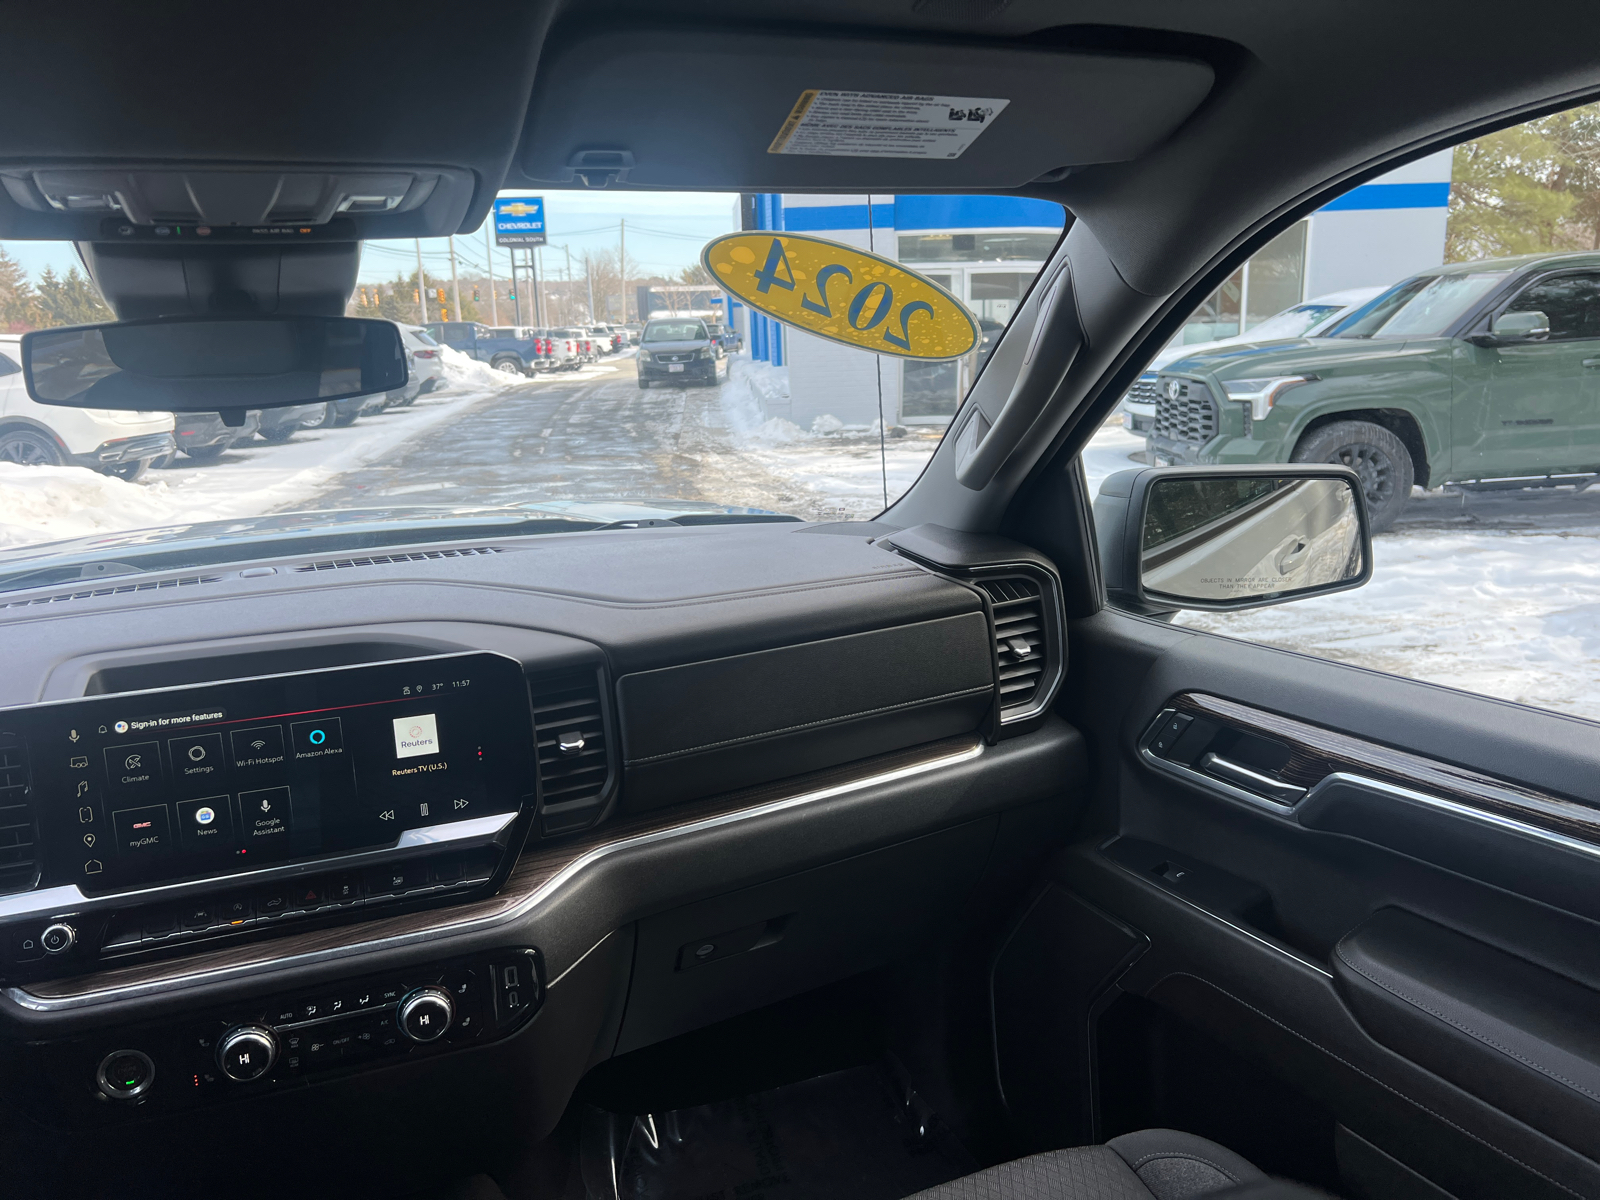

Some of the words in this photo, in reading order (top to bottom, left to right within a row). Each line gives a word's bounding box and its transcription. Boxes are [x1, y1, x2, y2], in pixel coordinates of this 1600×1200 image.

[131, 720, 157, 729] Sign-in
[192, 712, 222, 721] features
[401, 739, 433, 748] Reuters
[296, 750, 323, 759] Amazon
[236, 758, 254, 767] Wi-Fi
[256, 756, 284, 764] Hotspot
[184, 765, 214, 774] Settings
[392, 767, 418, 776] Reuters
[429, 762, 448, 772] (U.S.)
[122, 774, 150, 783] Climate
[255, 818, 281, 827] Google
[198, 828, 218, 836] News
[253, 826, 285, 836] Assistant
[130, 836, 159, 847] myGMC
[420, 1015, 430, 1026] HI
[239, 1053, 250, 1064] HI
